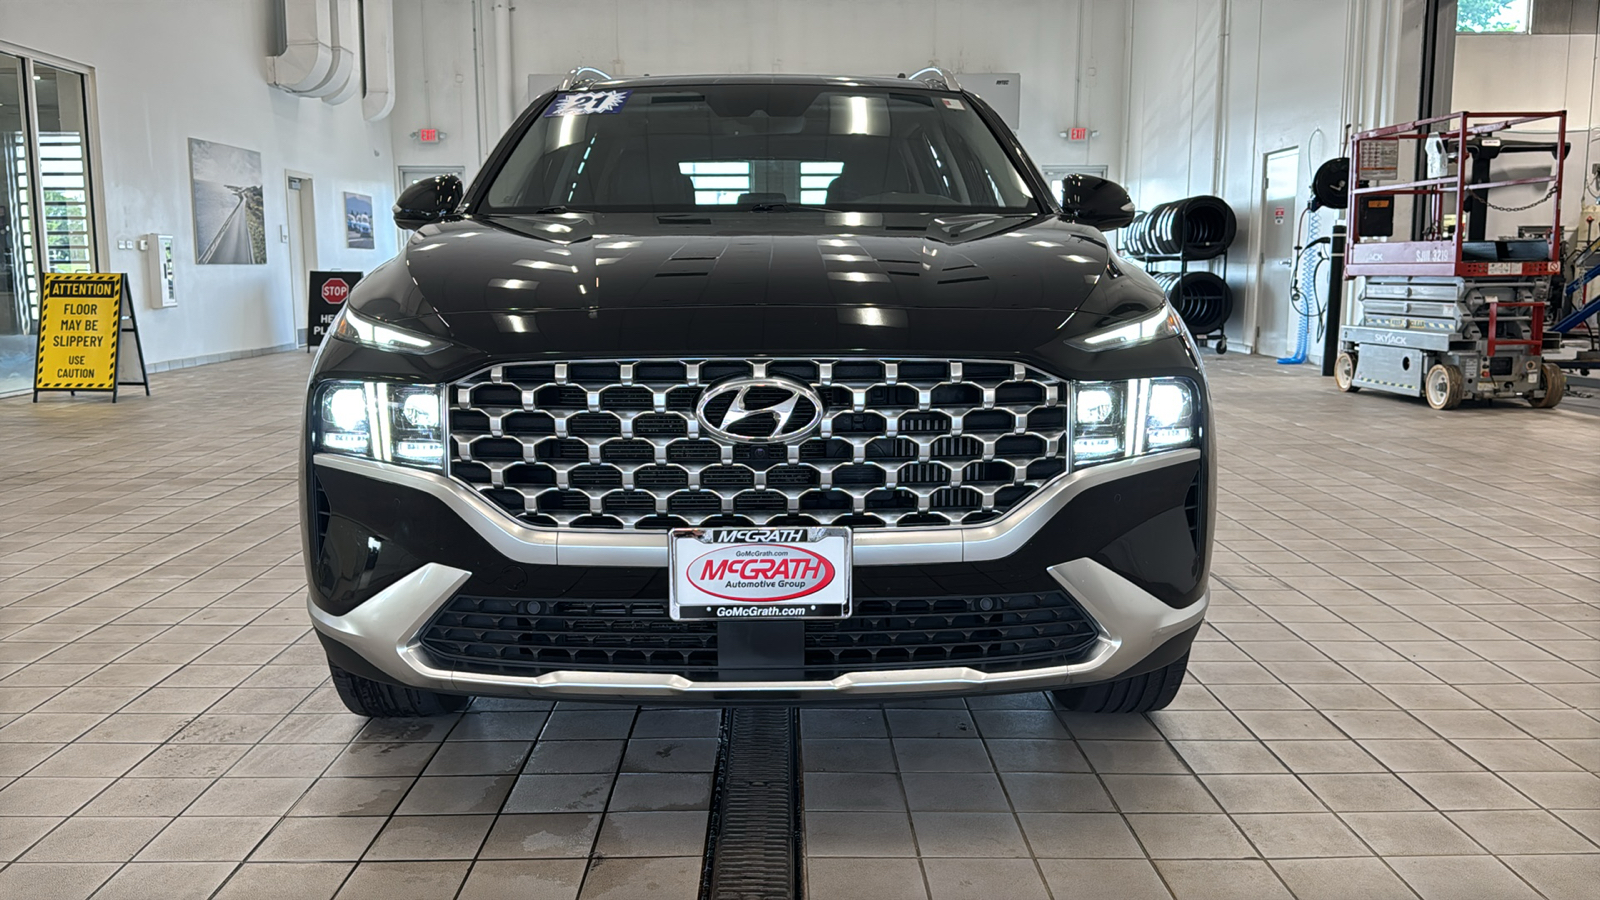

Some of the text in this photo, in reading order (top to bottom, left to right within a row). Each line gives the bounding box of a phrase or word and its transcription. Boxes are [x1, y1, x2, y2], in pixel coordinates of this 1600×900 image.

[567, 95, 609, 109] 21
[420, 129, 436, 141] EXIT
[1071, 127, 1086, 140] EXIT
[1432, 249, 1448, 262] 3219
[52, 283, 112, 295] ATTENTION
[323, 286, 347, 296] STOP
[63, 303, 98, 315] FLOOR
[320, 314, 334, 323] HE
[60, 320, 98, 331] MAY BE
[53, 336, 104, 347] SLIPPERY
[1374, 332, 1407, 345] SKYJACK
[68, 355, 85, 365] USE
[57, 368, 95, 378] CAUTION
[725, 580, 806, 589] Automotive Group
[716, 606, 806, 617] GoMcGrath.com
